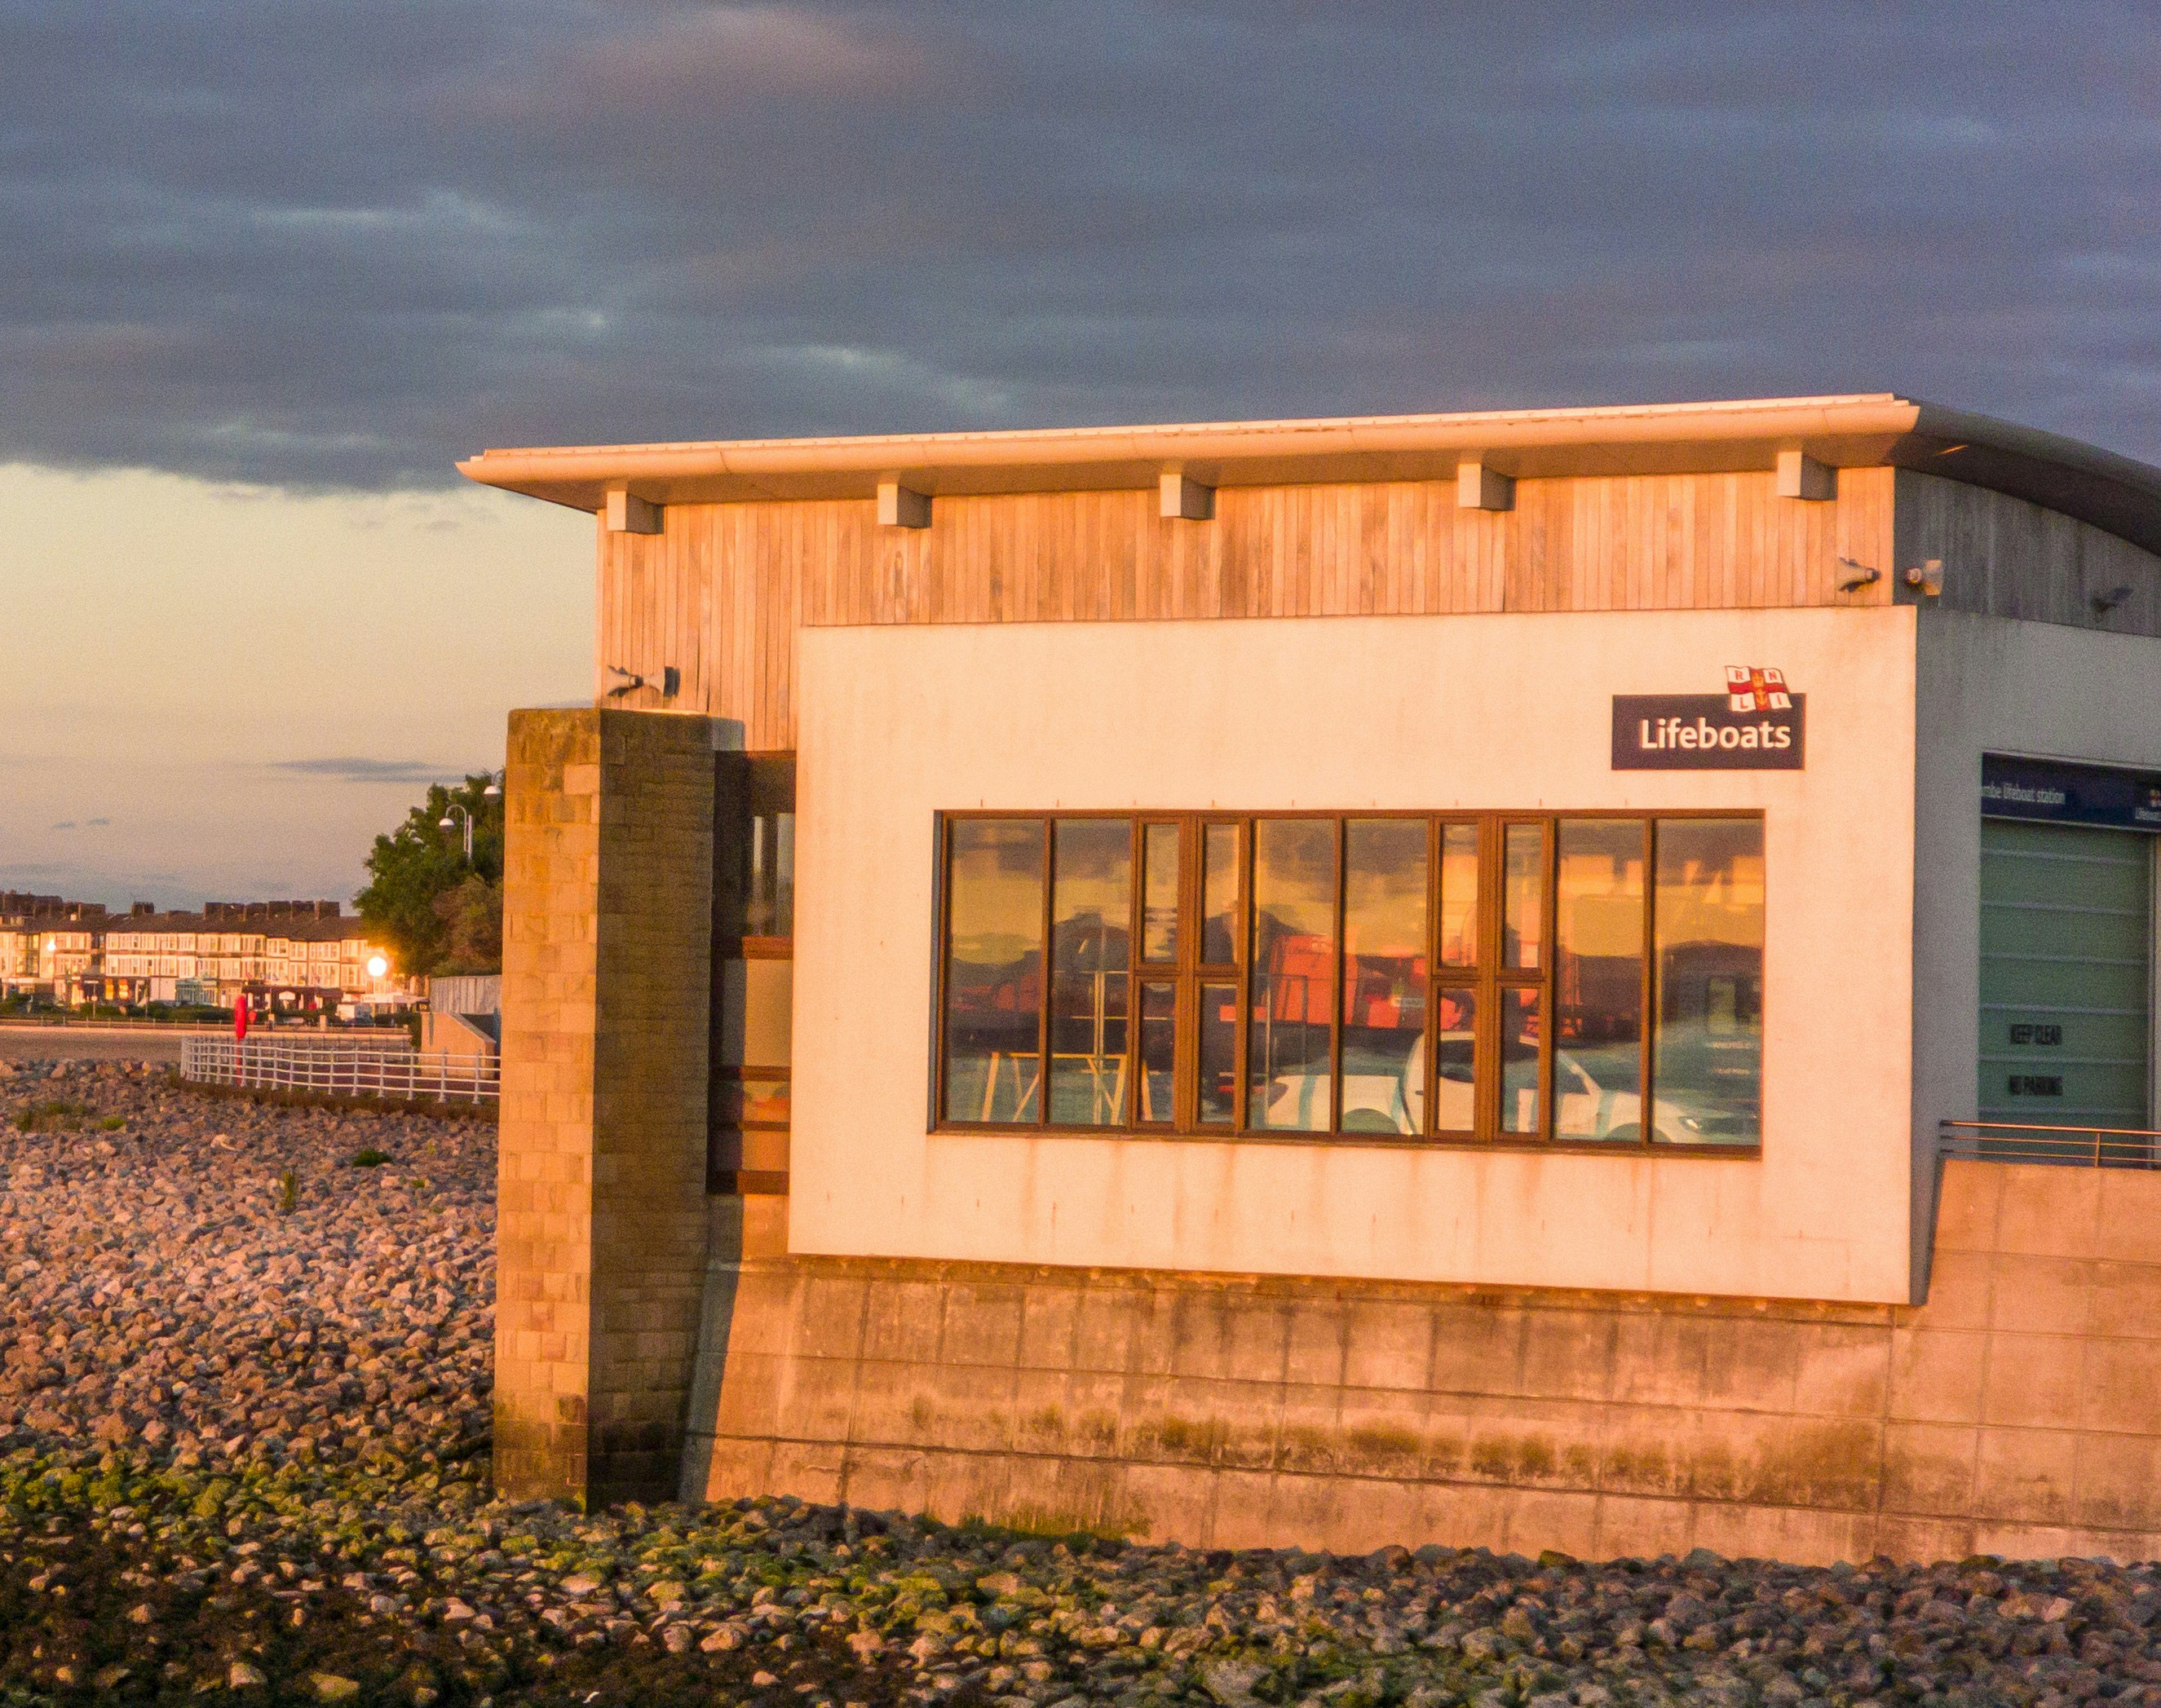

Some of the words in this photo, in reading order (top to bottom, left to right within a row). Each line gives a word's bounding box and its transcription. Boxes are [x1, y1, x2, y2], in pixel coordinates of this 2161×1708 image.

[1735, 669, 1743, 681] R
[1768, 669, 1777, 681] N
[1739, 699, 1748, 710] L
[1641, 717, 1792, 749] Lifeboats
